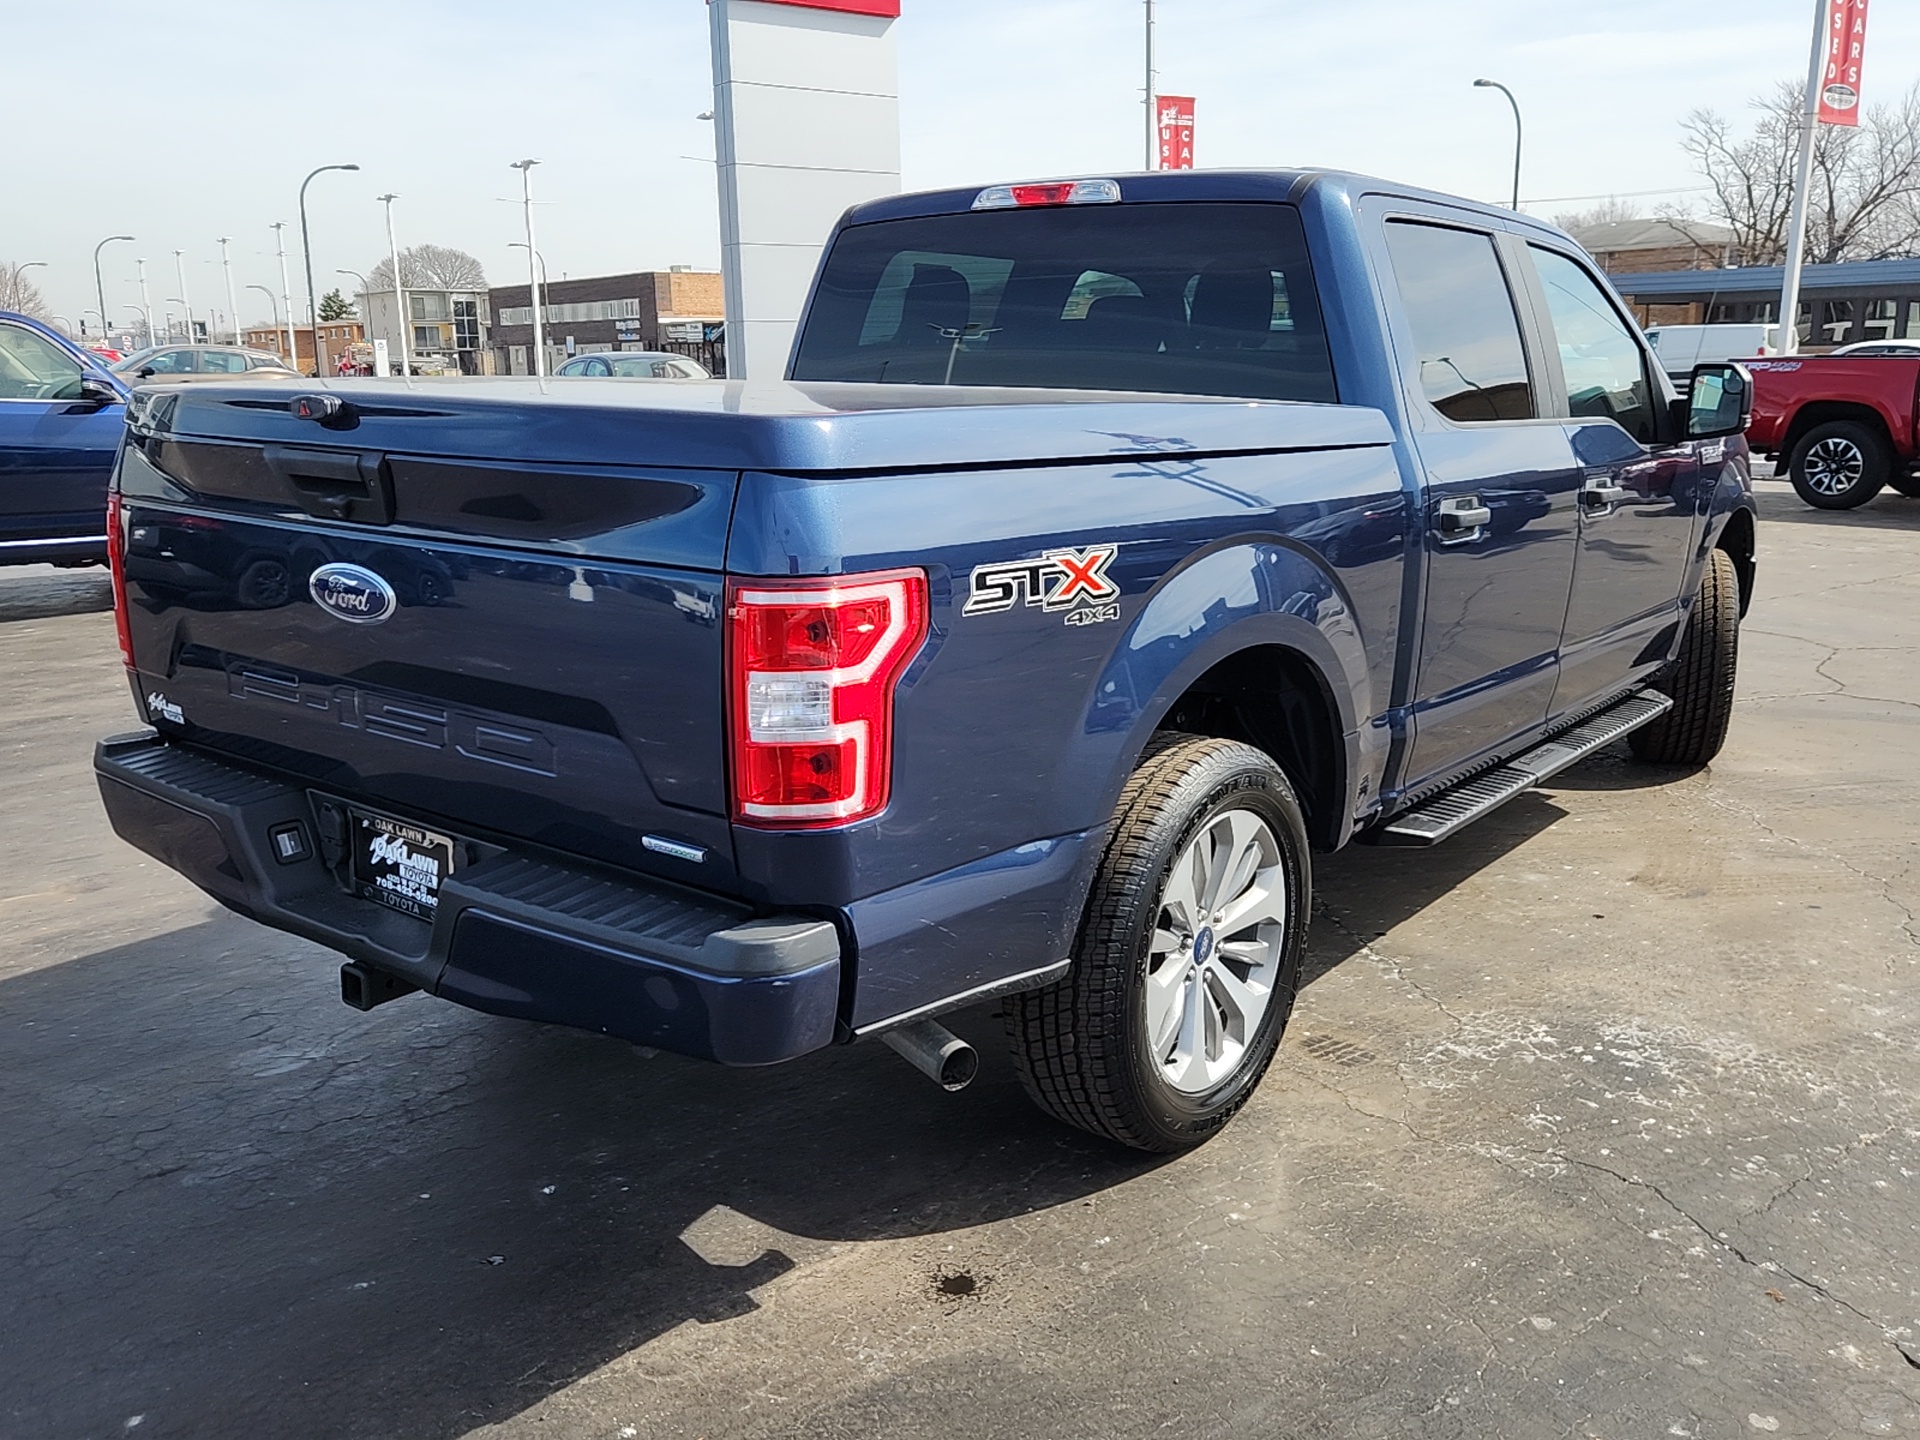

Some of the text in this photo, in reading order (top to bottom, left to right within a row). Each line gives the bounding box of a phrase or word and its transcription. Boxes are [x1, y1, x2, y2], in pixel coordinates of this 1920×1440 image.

[1828, 0, 1842, 79] SED
[323, 574, 371, 612] Ford
[961, 543, 1121, 618] STX
[374, 819, 423, 843] OAK LAWN
[403, 866, 434, 885] TOYOTA
[382, 892, 420, 914] TOYOTA
